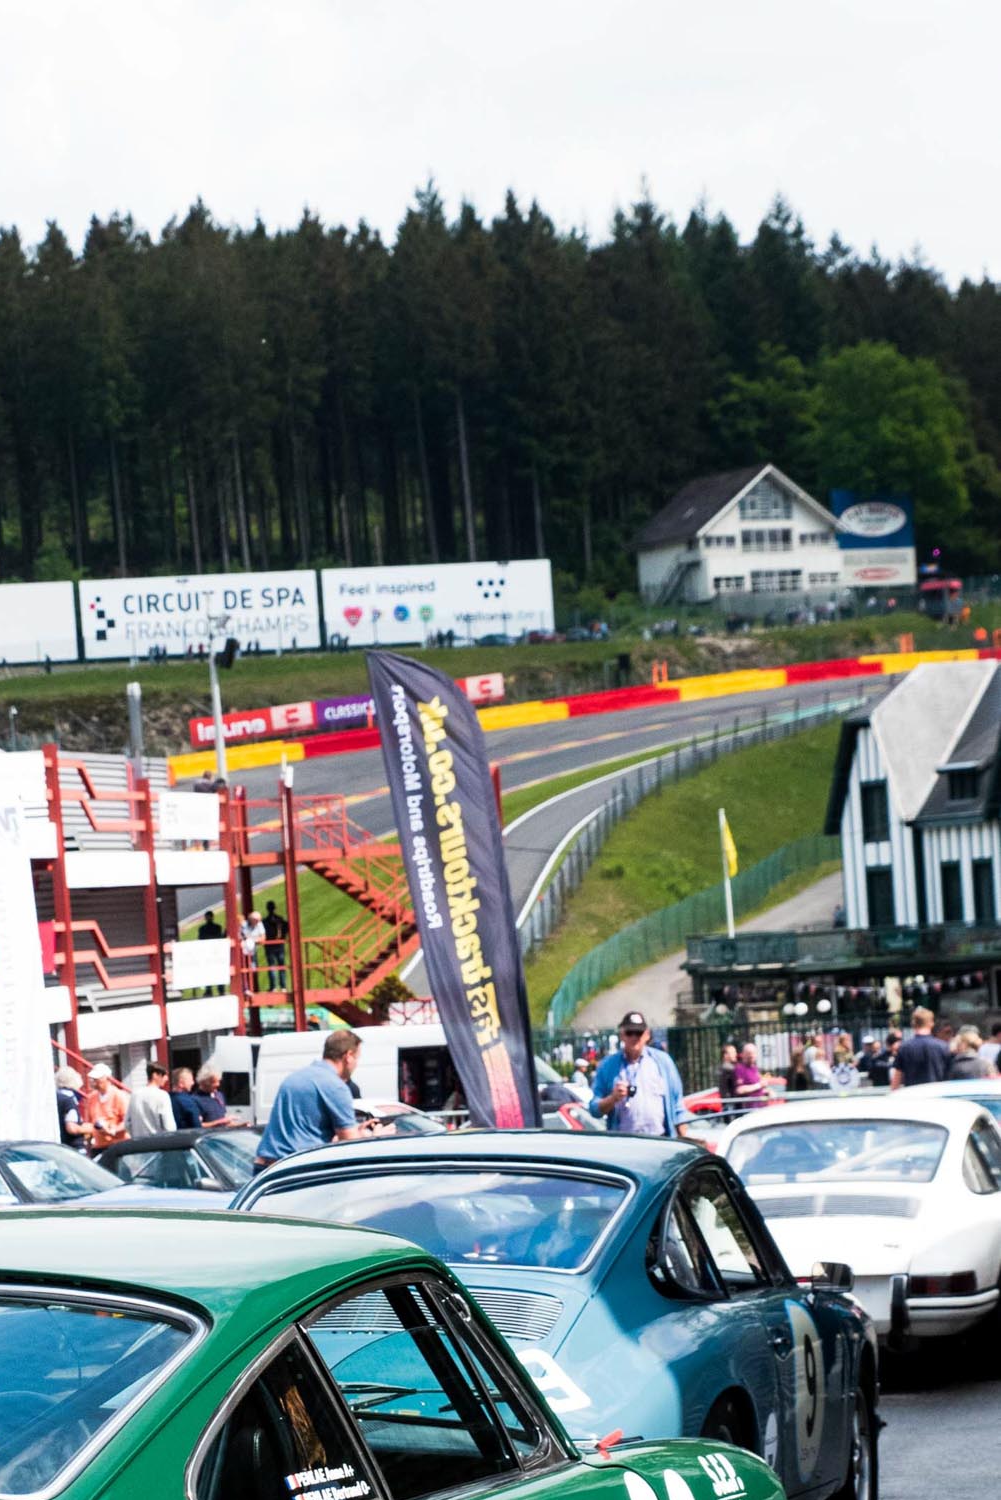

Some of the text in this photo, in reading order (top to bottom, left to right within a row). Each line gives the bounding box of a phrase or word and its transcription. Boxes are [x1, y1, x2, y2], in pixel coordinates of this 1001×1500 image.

[339, 581, 435, 595] Feel inspired
[224, 589, 253, 610] DE
[261, 587, 305, 608] SPA
